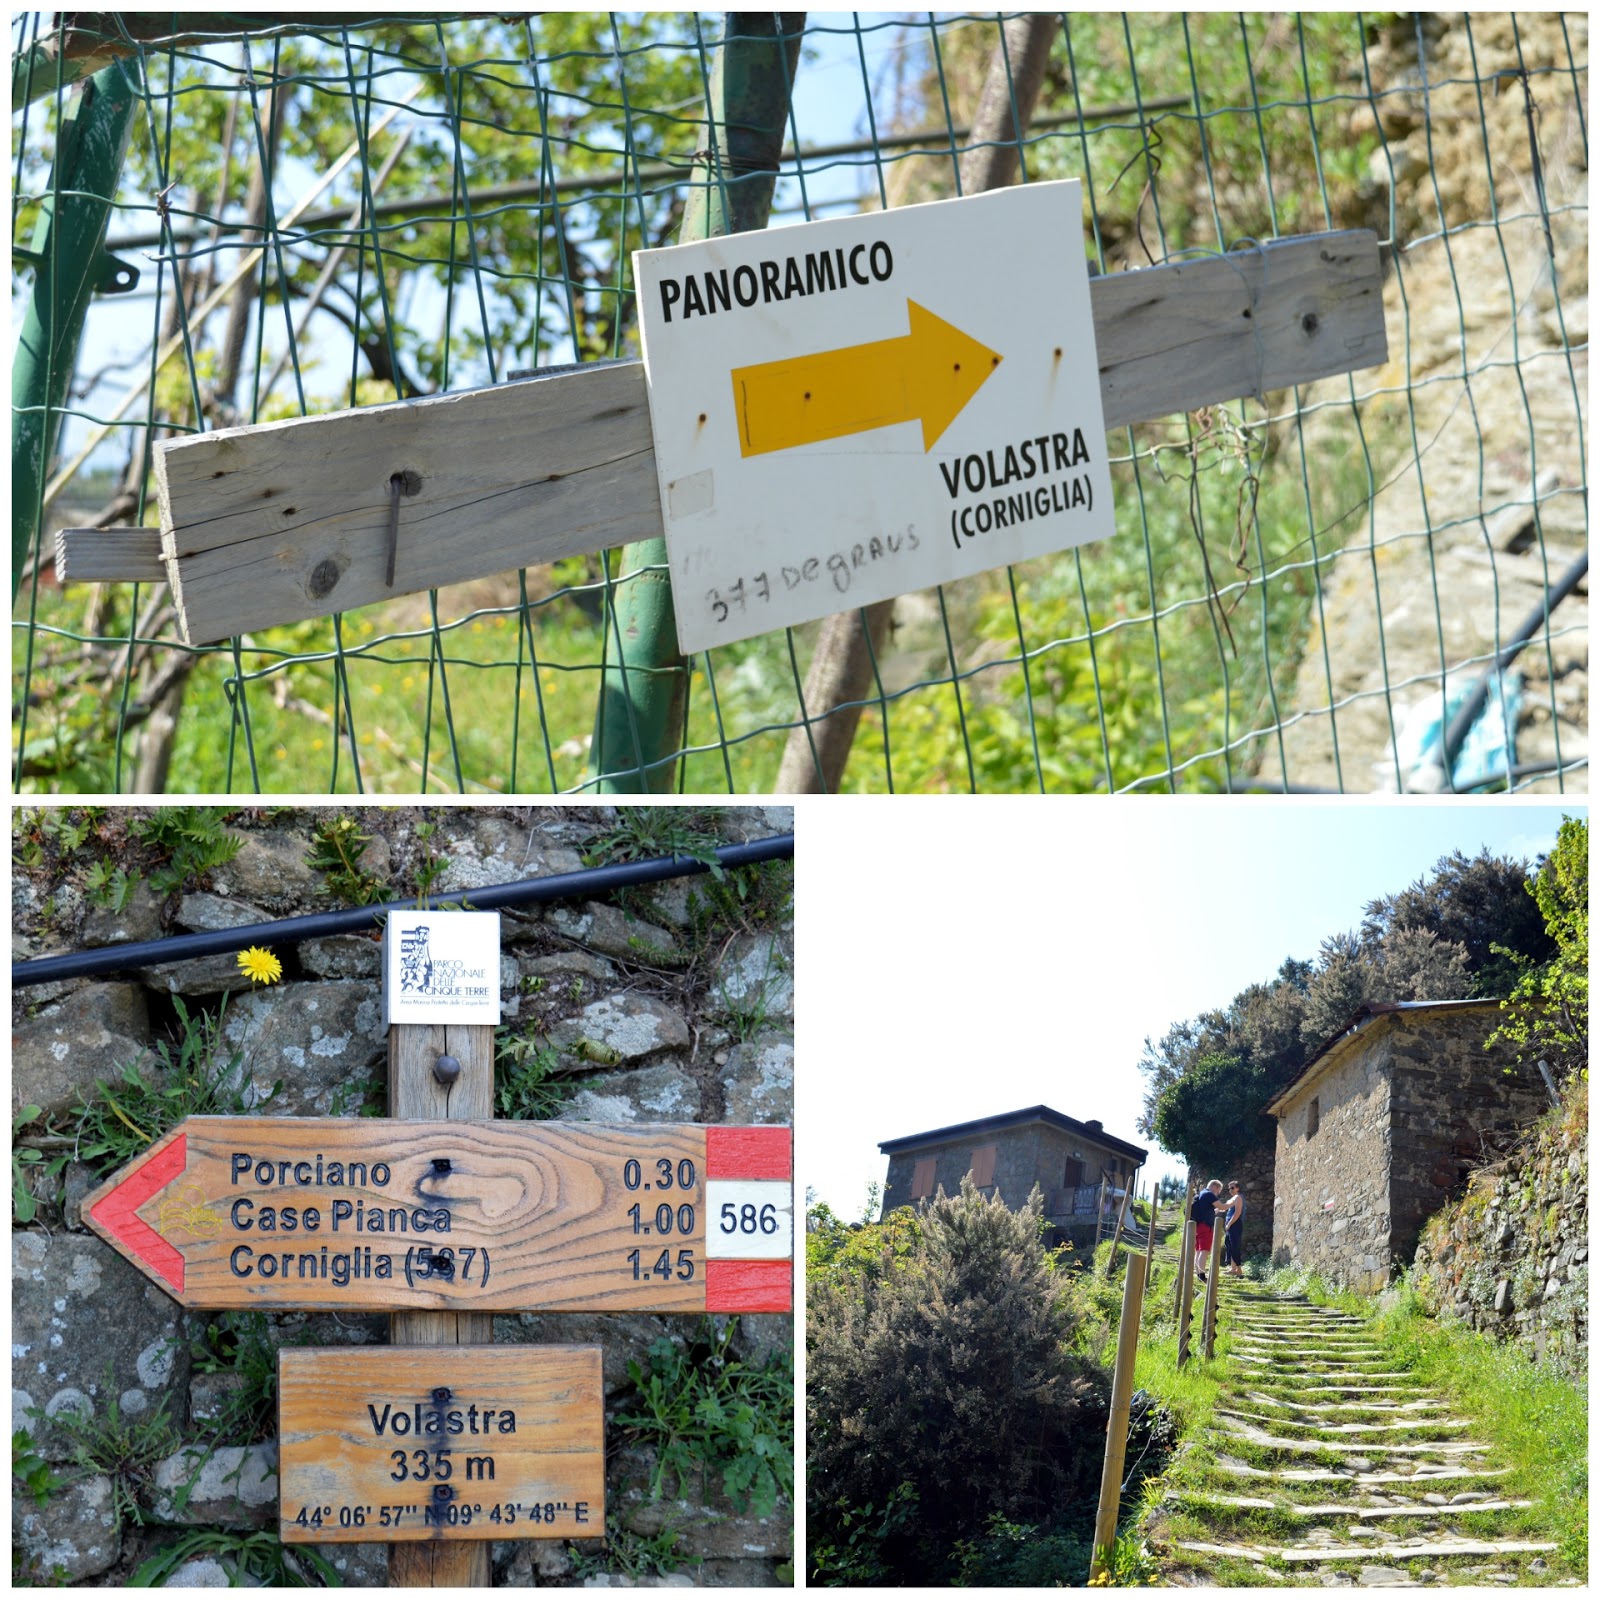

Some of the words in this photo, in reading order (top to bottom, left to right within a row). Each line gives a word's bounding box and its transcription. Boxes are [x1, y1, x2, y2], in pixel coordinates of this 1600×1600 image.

[659, 240, 894, 323] PANORAMICO
[939, 428, 1091, 499] VOLASTRA
[950, 474, 1094, 550] (CORNIGLIA)
[433, 959, 464, 969] PARCO
[433, 968, 486, 978] NAZIONALE
[424, 986, 462, 996] CINQUE
[465, 986, 490, 996] TERRE
[433, 977, 456, 987] DELLE
[231, 1152, 392, 1187] Porciano
[623, 1158, 696, 1191] 0.30
[230, 1198, 321, 1232] Case
[332, 1199, 452, 1233] Pianca
[627, 1203, 695, 1235] 1.00
[719, 1203, 777, 1235] 586
[230, 1244, 393, 1287] Corniglia
[627, 1249, 695, 1281] 1.45
[367, 1403, 517, 1436] Volastra
[390, 1450, 452, 1482] 335
[466, 1454, 495, 1480] m
[424, 1504, 442, 1526] N
[575, 1501, 589, 1523] E
